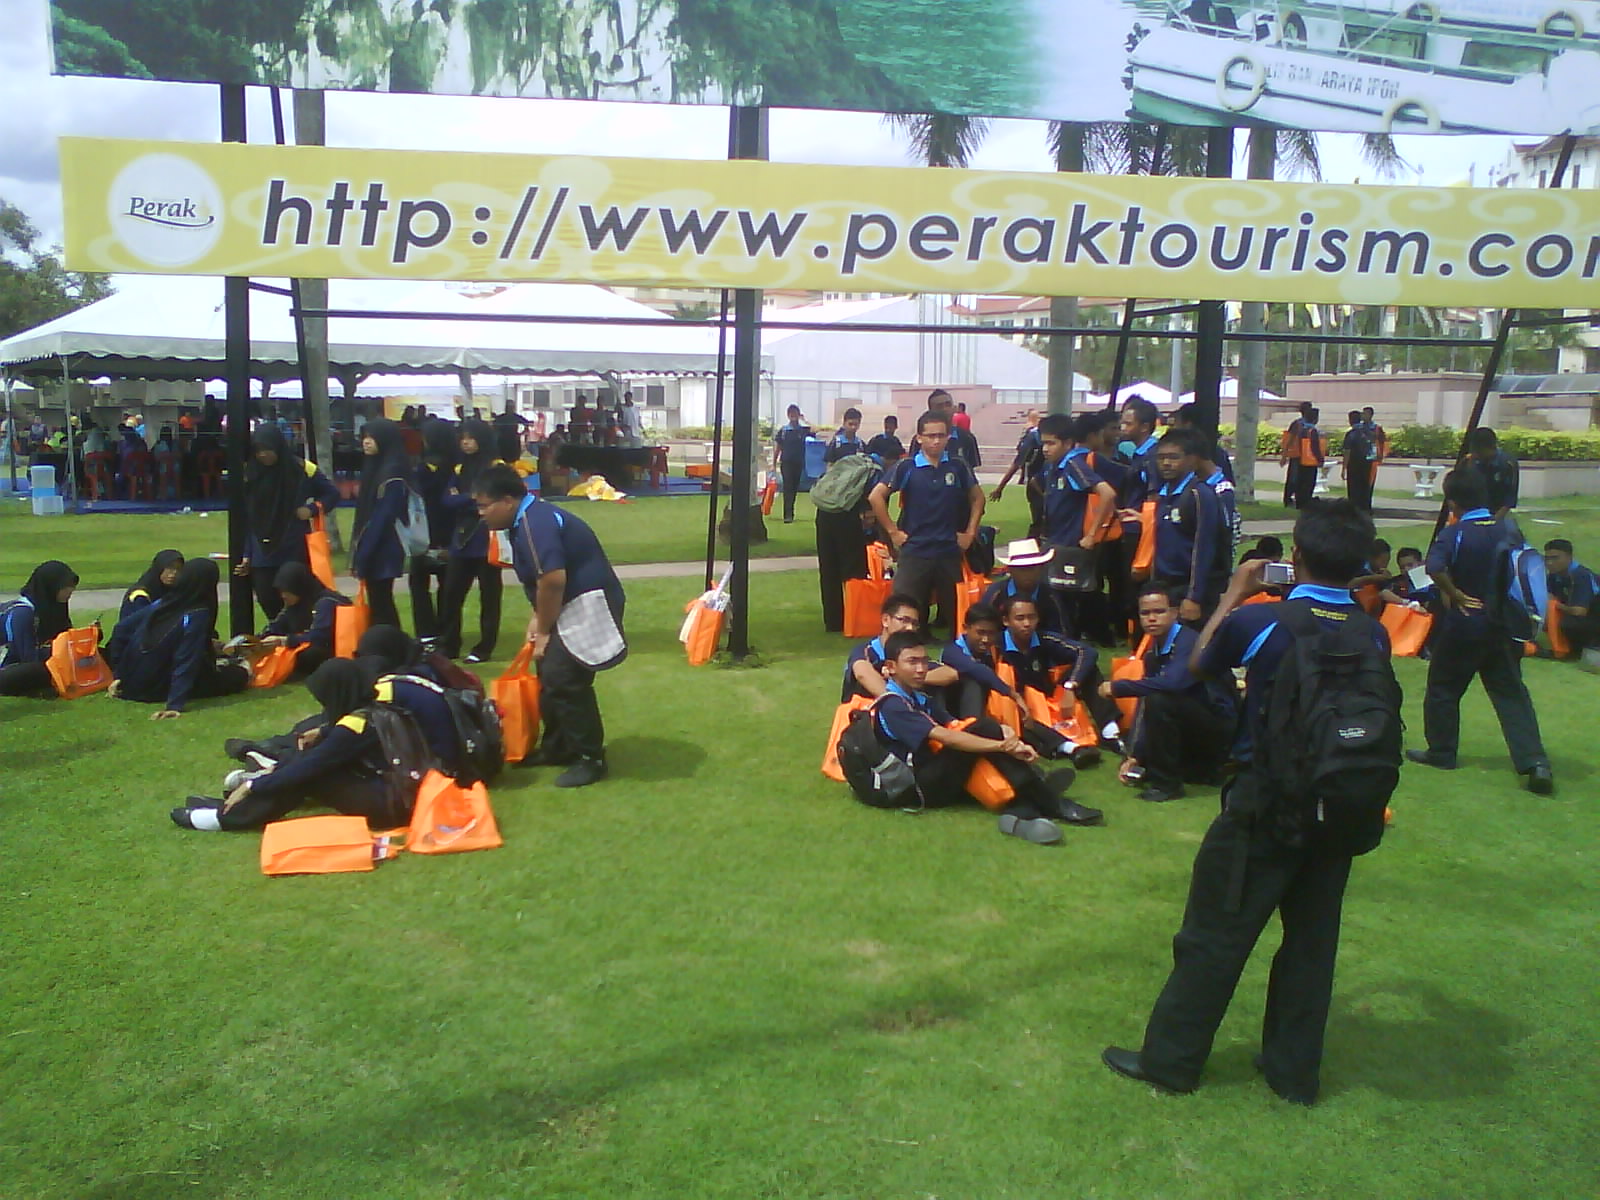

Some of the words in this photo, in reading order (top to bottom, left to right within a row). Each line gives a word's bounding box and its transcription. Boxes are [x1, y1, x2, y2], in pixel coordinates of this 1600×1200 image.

[1288, 64, 1362, 94] BANARAYA
[1367, 76, 1400, 99] IPOH
[130, 197, 196, 217] Perak
[262, 179, 1600, 278] http://www.peraktourism.co
